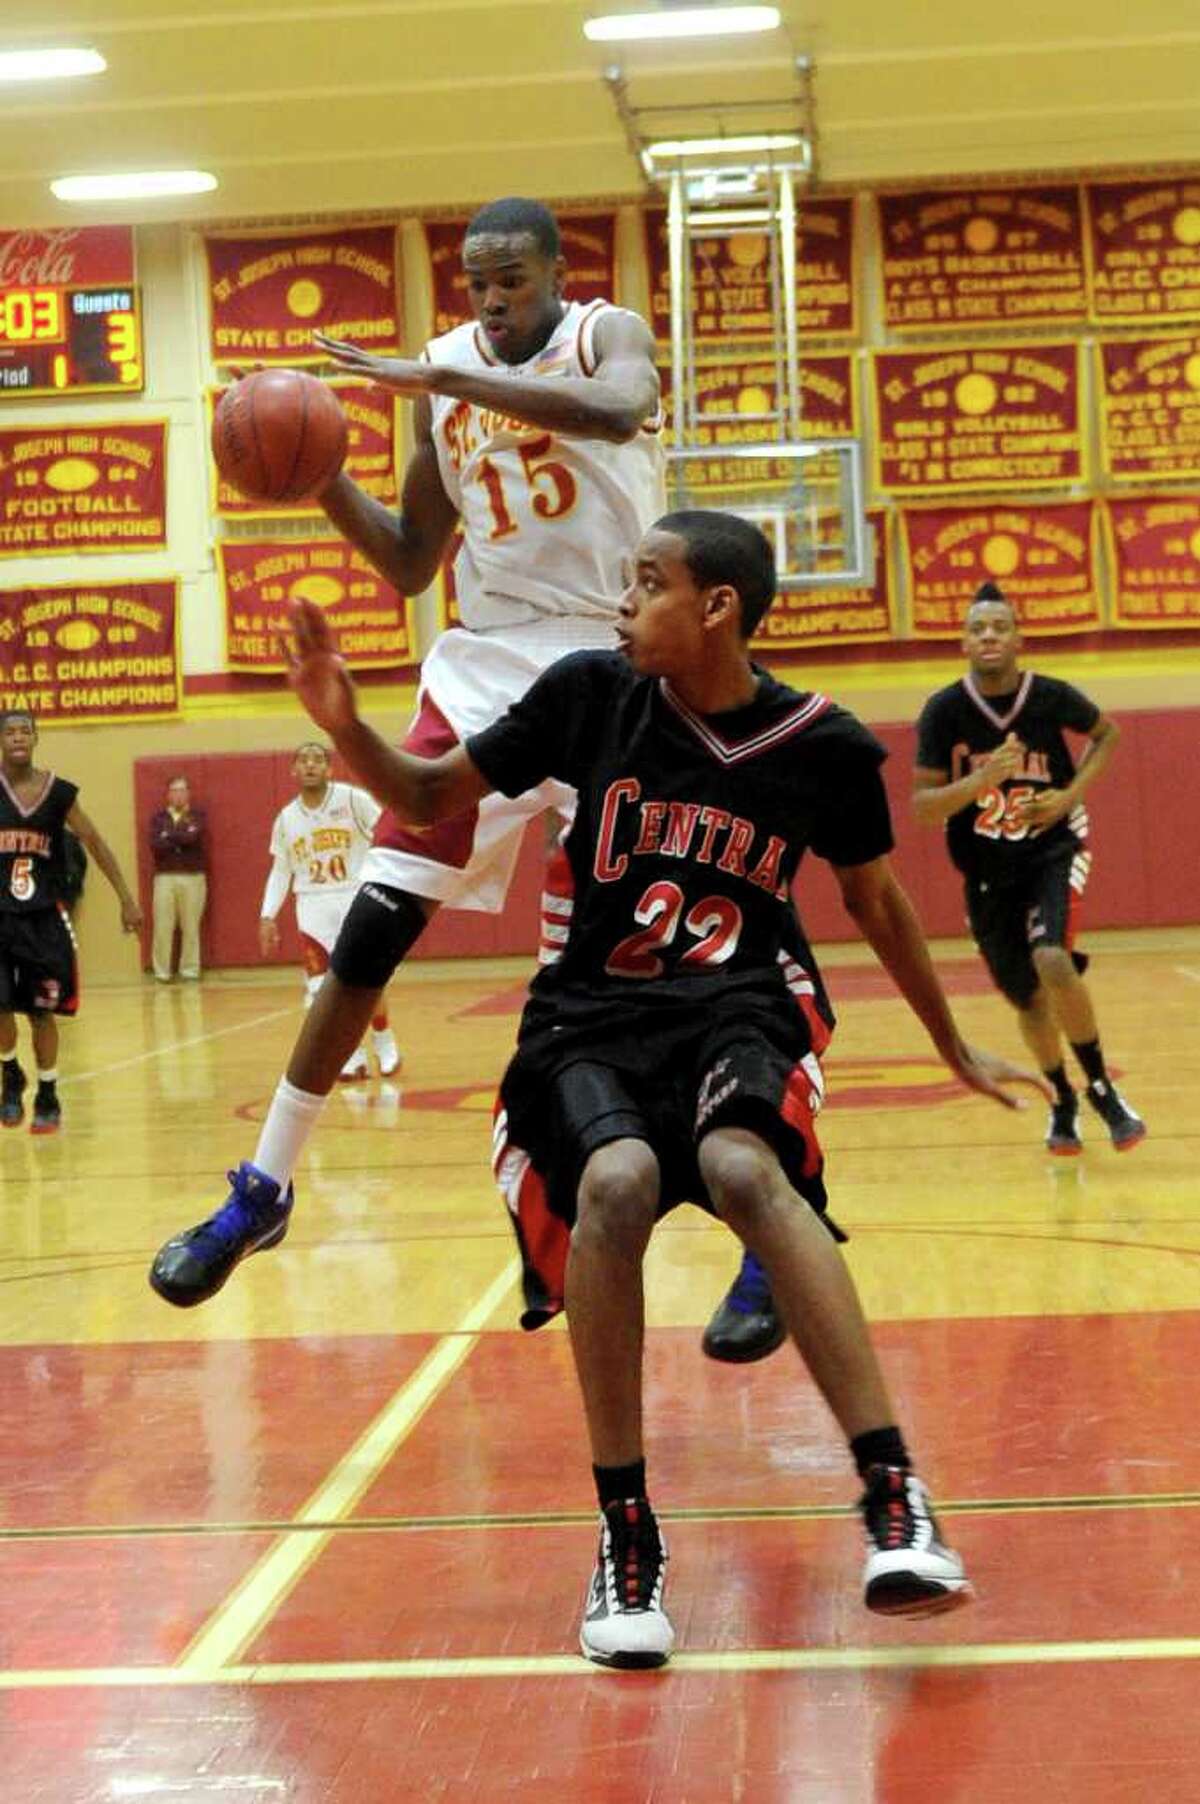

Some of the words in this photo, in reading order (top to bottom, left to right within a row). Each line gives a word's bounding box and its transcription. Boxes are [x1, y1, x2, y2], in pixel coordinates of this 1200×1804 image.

[237, 251, 295, 288] JOSEPH
[295, 248, 332, 266] HIGH
[335, 247, 392, 288] SCHOOL
[943, 251, 1081, 274] BASKETBALL
[957, 271, 1082, 293] CHAMPIONS
[109, 312, 137, 363] 3
[214, 327, 279, 348] STATE
[284, 317, 396, 345] CHMPIONS
[54, 354, 68, 388] 1
[953, 412, 1067, 434] VOLLEYBALL
[13, 436, 65, 464] JOSEPH
[66, 435, 99, 453] HIGH
[102, 436, 154, 469] SCHOOL
[950, 454, 1063, 480] CONNECTICUT
[476, 432, 578, 541] 15
[5, 493, 142, 519] FOOTBALL
[0, 521, 49, 544] TATE
[53, 517, 162, 540] CHAMPIONS
[252, 552, 306, 583] JOSEPH
[309, 549, 344, 568] HIGH
[22, 598, 73, 628] JOSEPH
[75, 593, 110, 616] HIGH
[111, 597, 162, 633] SCHOOL
[767, 608, 889, 636] CHAMPIONS
[56, 655, 174, 681] CHAMPIONS
[60, 683, 176, 708] CHAMPIONS
[973, 786, 1037, 842] 25
[10, 857, 37, 901] 5
[309, 855, 348, 885] 20
[604, 879, 744, 980] 22
